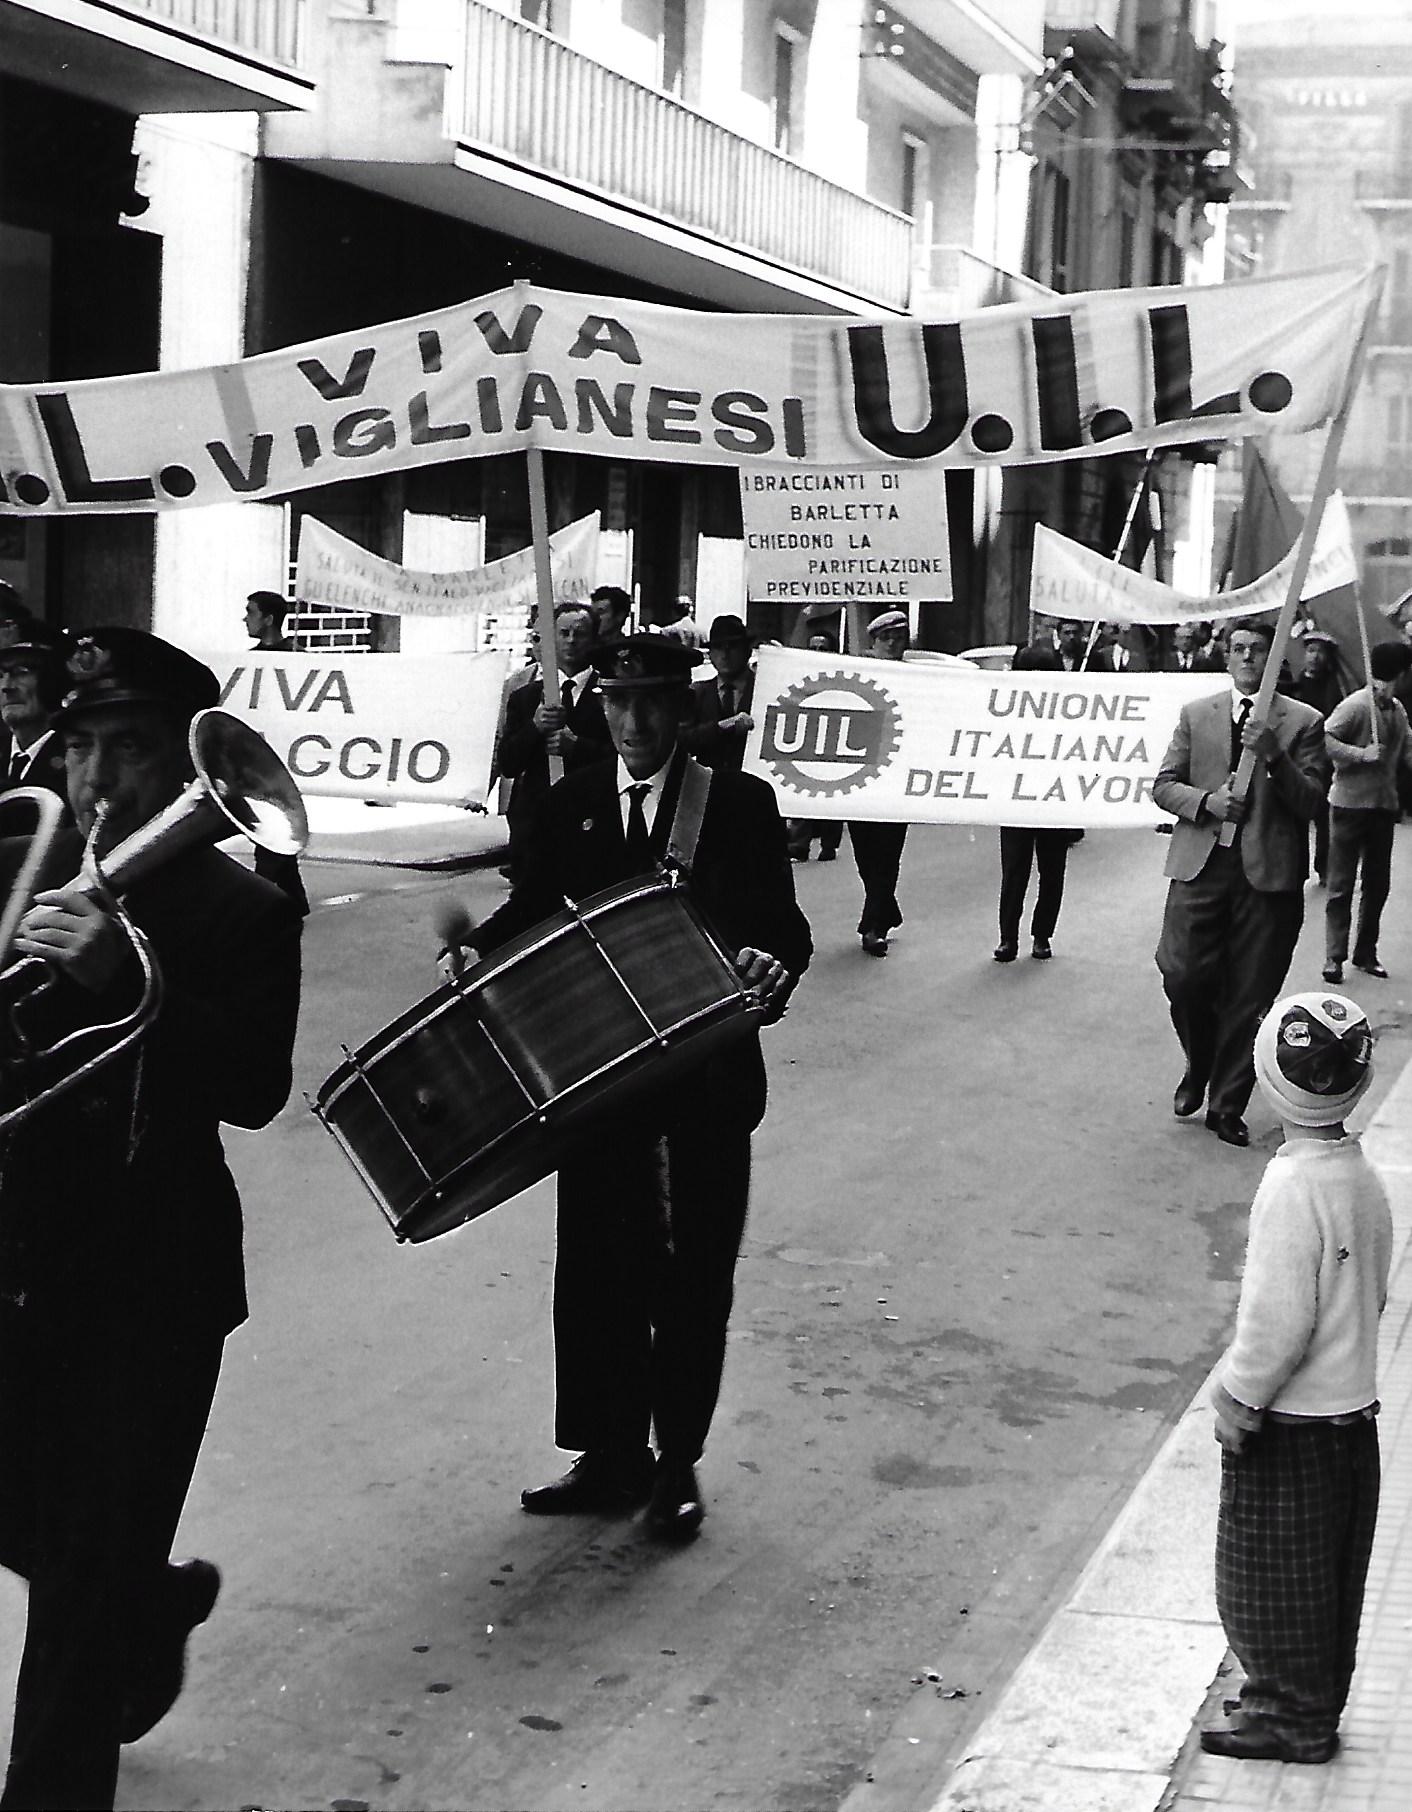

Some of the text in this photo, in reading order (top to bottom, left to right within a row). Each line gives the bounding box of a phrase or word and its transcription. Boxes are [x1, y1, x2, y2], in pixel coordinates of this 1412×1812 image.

[298, 304, 642, 400] VIVA
[847, 303, 1293, 460] U.I.L.
[0, 393, 196, 503] .L.
[206, 371, 807, 492] VIGLIANESI
[755, 474, 865, 491] BRACCIANTI
[881, 473, 900, 490] DI
[791, 504, 900, 521] BARLETTA
[748, 533, 872, 550] CHIEDONO LA
[808, 558, 943, 574] PARIFICAZIONE
[766, 580, 910, 596] PREVIDENZIALE
[216, 666, 355, 715] VIVA
[987, 688, 1151, 722] UNIONE
[773, 712, 868, 758] UIL
[949, 729, 1150, 763] ITALIANA
[262, 731, 451, 784] GGIO
[904, 768, 1155, 803] DEL LAVOR
